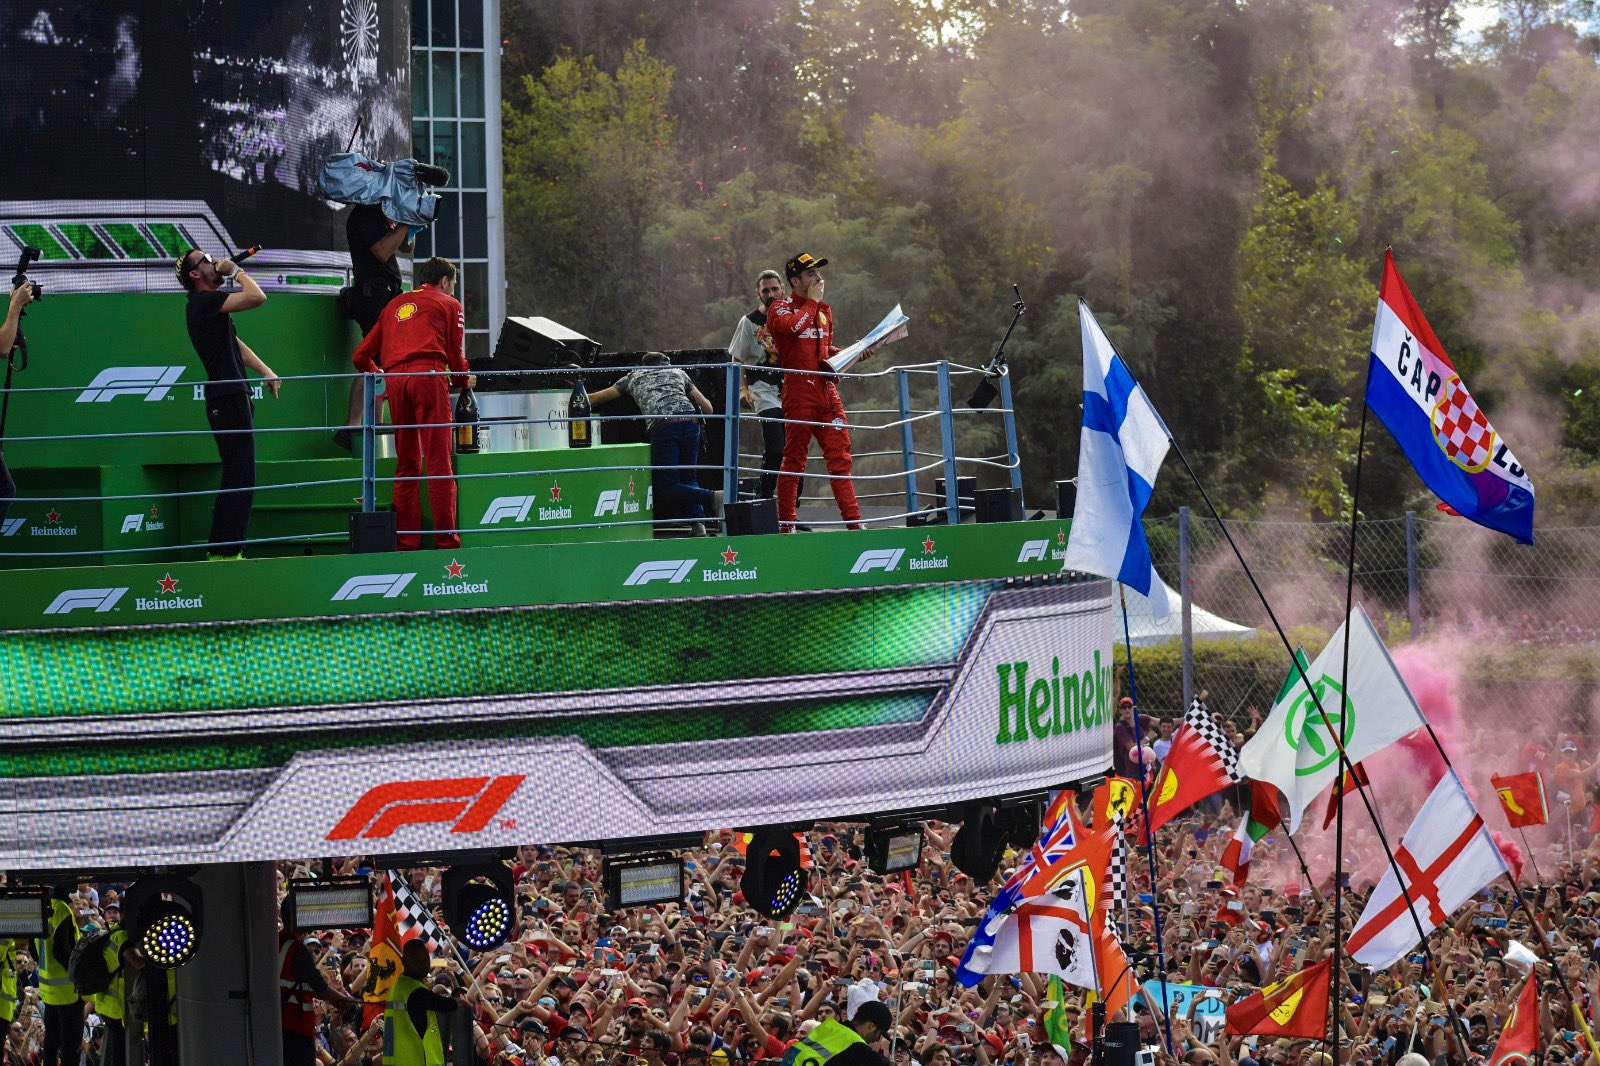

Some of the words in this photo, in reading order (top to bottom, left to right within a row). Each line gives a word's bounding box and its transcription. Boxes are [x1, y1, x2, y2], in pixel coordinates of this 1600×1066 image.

[75, 366, 187, 403] F1
[480, 495, 536, 524] F1
[539, 504, 572, 521] Heineken
[594, 489, 622, 517] F1
[31, 526, 77, 536] Heineken
[120, 514, 145, 534] F1
[849, 548, 906, 574] F1
[909, 556, 948, 570] Heineken
[1017, 539, 1049, 563] F1
[623, 558, 698, 586] F1
[703, 566, 757, 582] Heineken
[330, 572, 418, 601] F1
[423, 581, 488, 596] Heineken
[42, 587, 130, 615] F1
[135, 596, 203, 611] Heineken
[996, 649, 1112, 745] Heineke
[324, 774, 528, 841] F1
